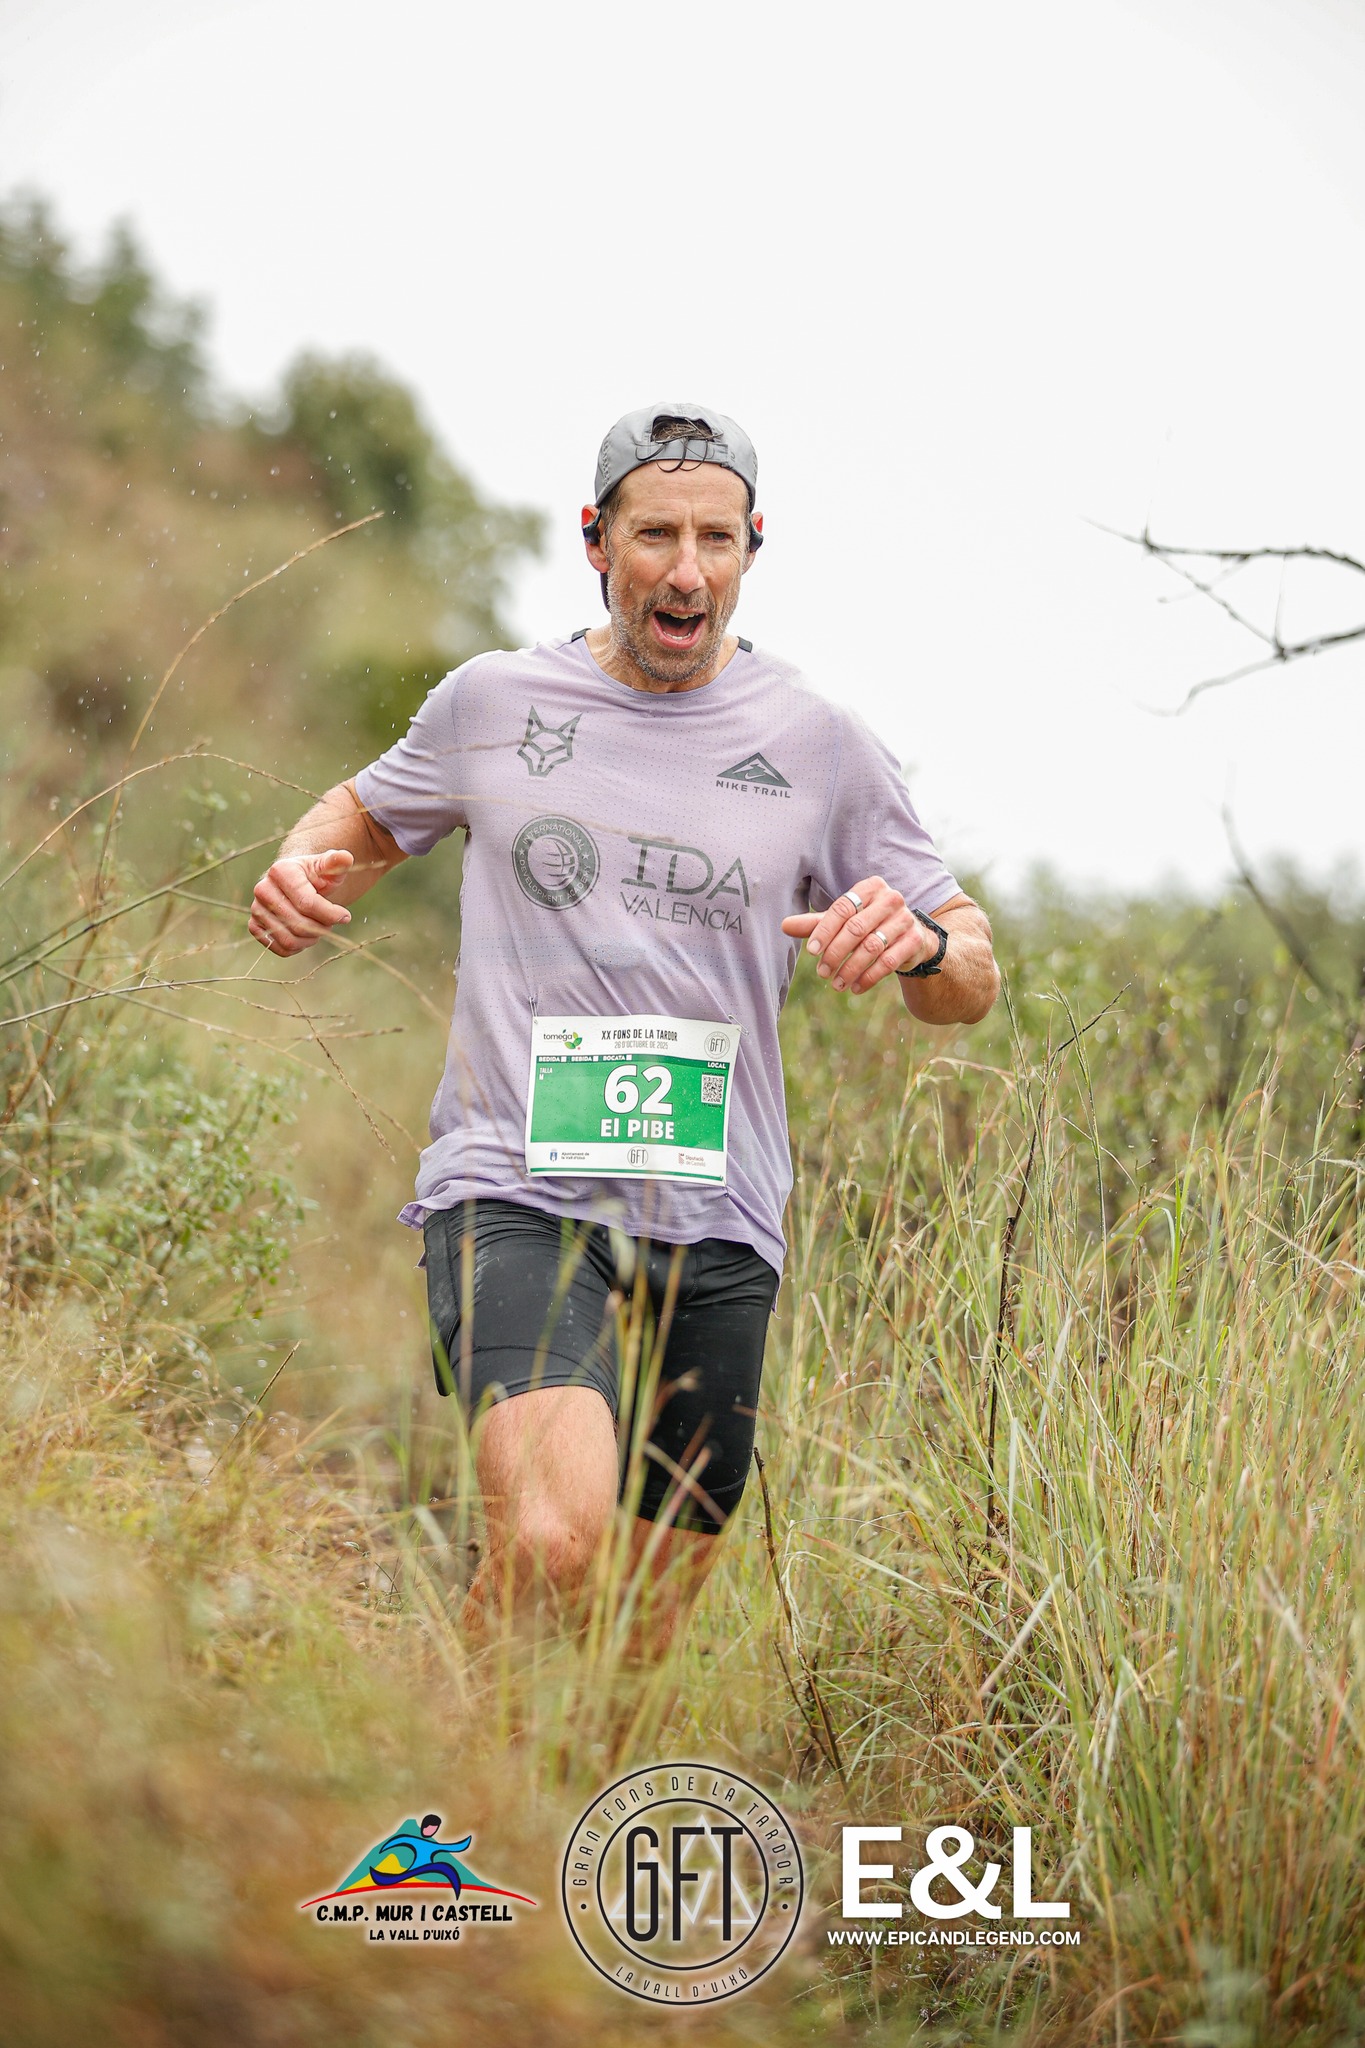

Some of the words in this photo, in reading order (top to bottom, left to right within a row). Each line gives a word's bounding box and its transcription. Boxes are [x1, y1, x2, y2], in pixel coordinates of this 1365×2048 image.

[716, 780, 748, 794] NIKE
[753, 786, 791, 799] TRAIL
[522, 824, 585, 850] INTERNATIONAL
[519, 859, 563, 903] DEVELOPMENT
[566, 864, 592, 900] ACADEMY
[620, 836, 750, 908] IDA
[619, 891, 743, 935] VALENCIA
[601, 1030, 611, 1041] XX
[612, 1029, 631, 1040] FONS
[633, 1028, 642, 1039] DE
[644, 1028, 654, 1039] LA
[656, 1029, 678, 1042] TARDOR
[614, 1041, 621, 1049] 26
[649, 1041, 656, 1049] DE
[656, 1041, 668, 1050] 2025
[709, 1038, 725, 1053] GFT
[707, 1061, 726, 1069] LOCAL
[538, 1073, 544, 1081] M
[604, 1064, 673, 1116] 62
[627, 1118, 675, 1140] PIBE
[630, 1149, 645, 1164] GFT
